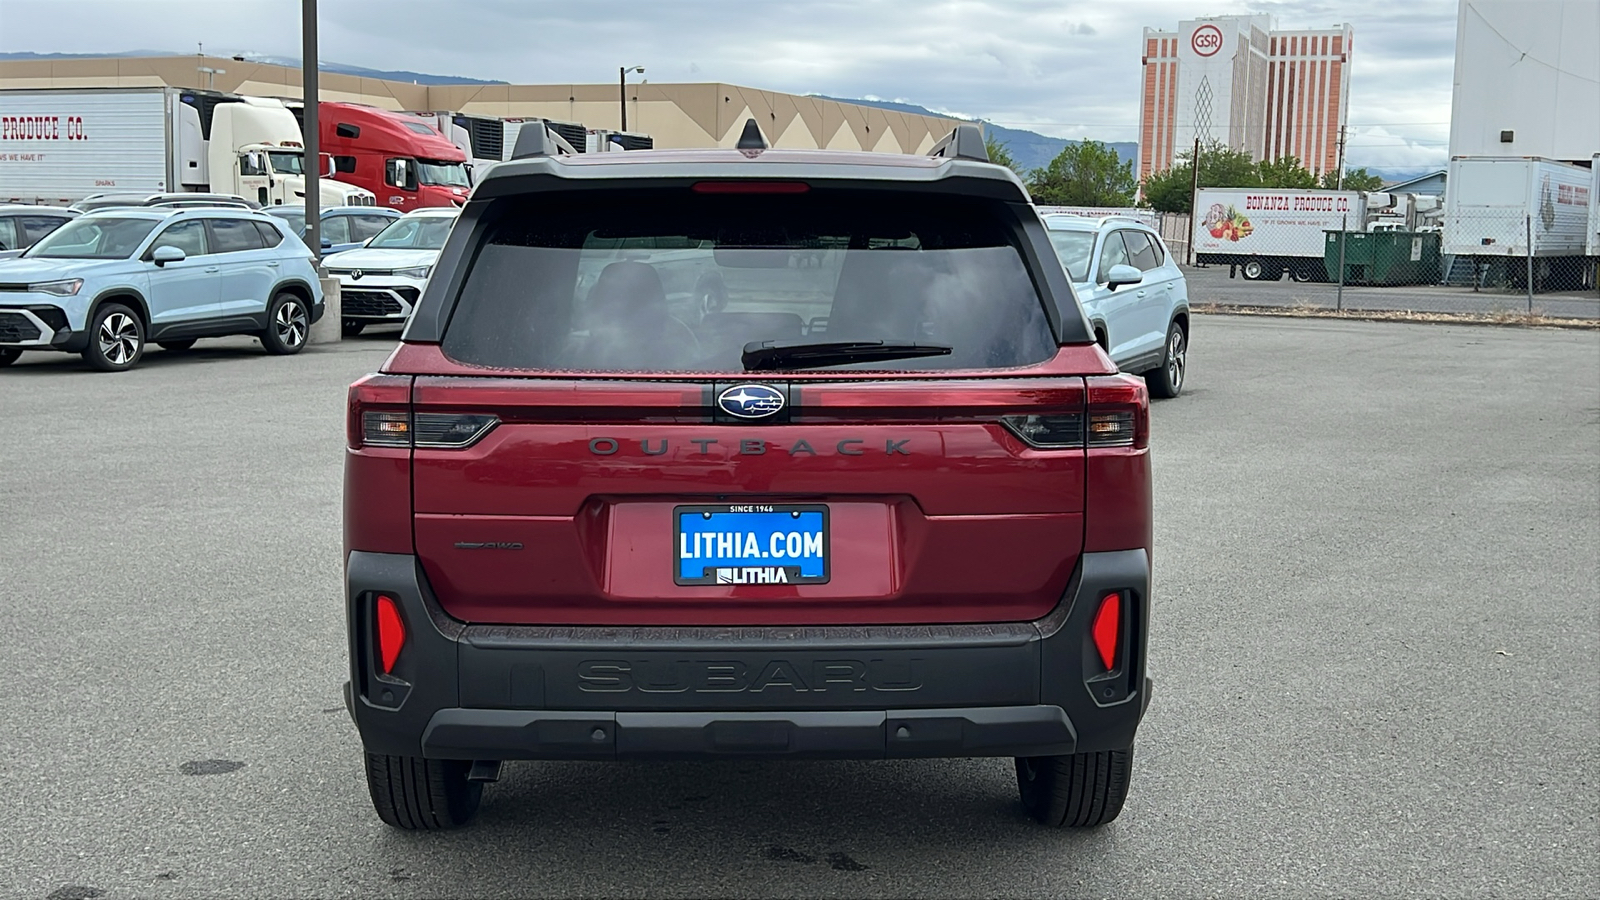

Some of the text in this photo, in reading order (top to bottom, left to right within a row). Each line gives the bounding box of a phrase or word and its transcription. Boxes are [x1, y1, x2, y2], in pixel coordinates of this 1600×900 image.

[1195, 34, 1218, 47] GSR
[2, 116, 88, 140] PRODUCE CO.
[9, 153, 19, 161] WE
[20, 153, 36, 161] HAVE
[1246, 195, 1351, 212] BONANZA PRODUCE CO.
[588, 437, 911, 455] OUTBACK
[729, 505, 774, 513] SINCE 1946
[680, 531, 823, 559] LITHIA.COM
[732, 567, 788, 584] LITHIA
[577, 658, 926, 693] SUBARU
